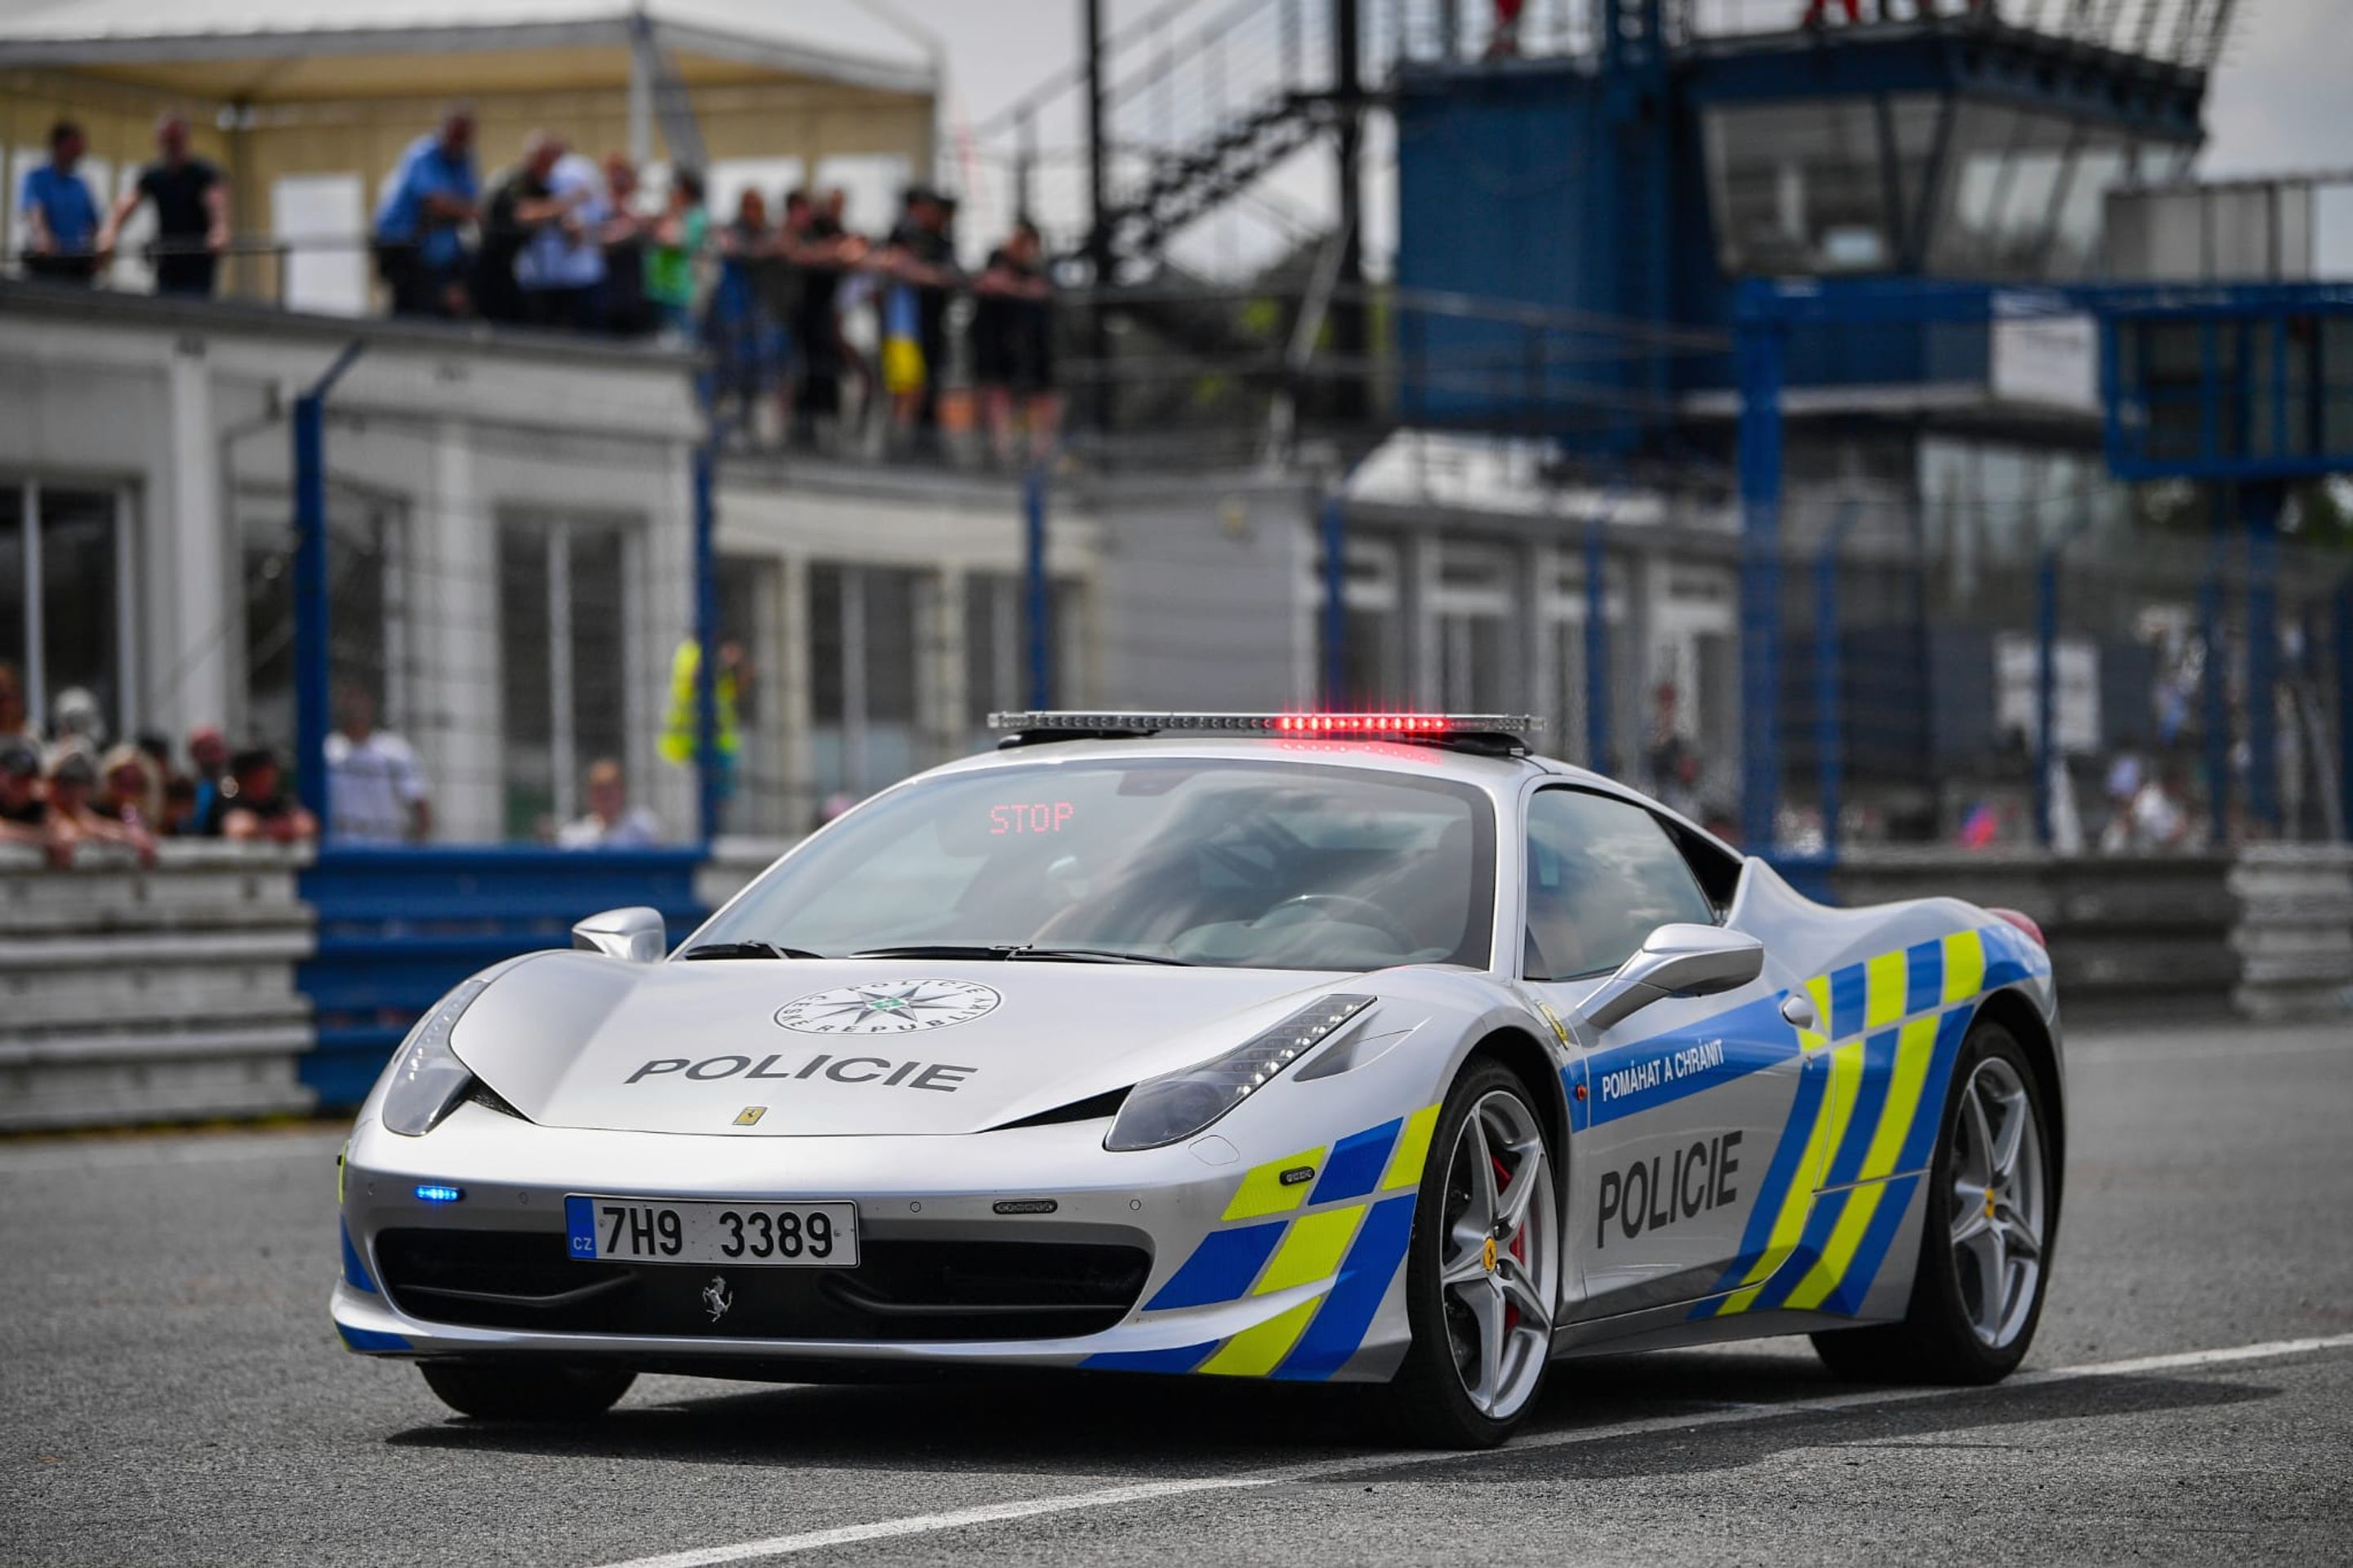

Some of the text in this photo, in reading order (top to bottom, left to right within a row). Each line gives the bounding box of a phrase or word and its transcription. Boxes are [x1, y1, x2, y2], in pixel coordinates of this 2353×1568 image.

[990, 802, 1074, 834] STOP
[816, 998, 994, 1032] REPUBLIKY
[623, 1054, 979, 1093] POLICIE
[1602, 1038, 1724, 1102] POMÁHAT A CHRÁNIT
[1598, 1130, 1743, 1249] POLICIE
[573, 1206, 833, 1258] CZ 7H9 3389
